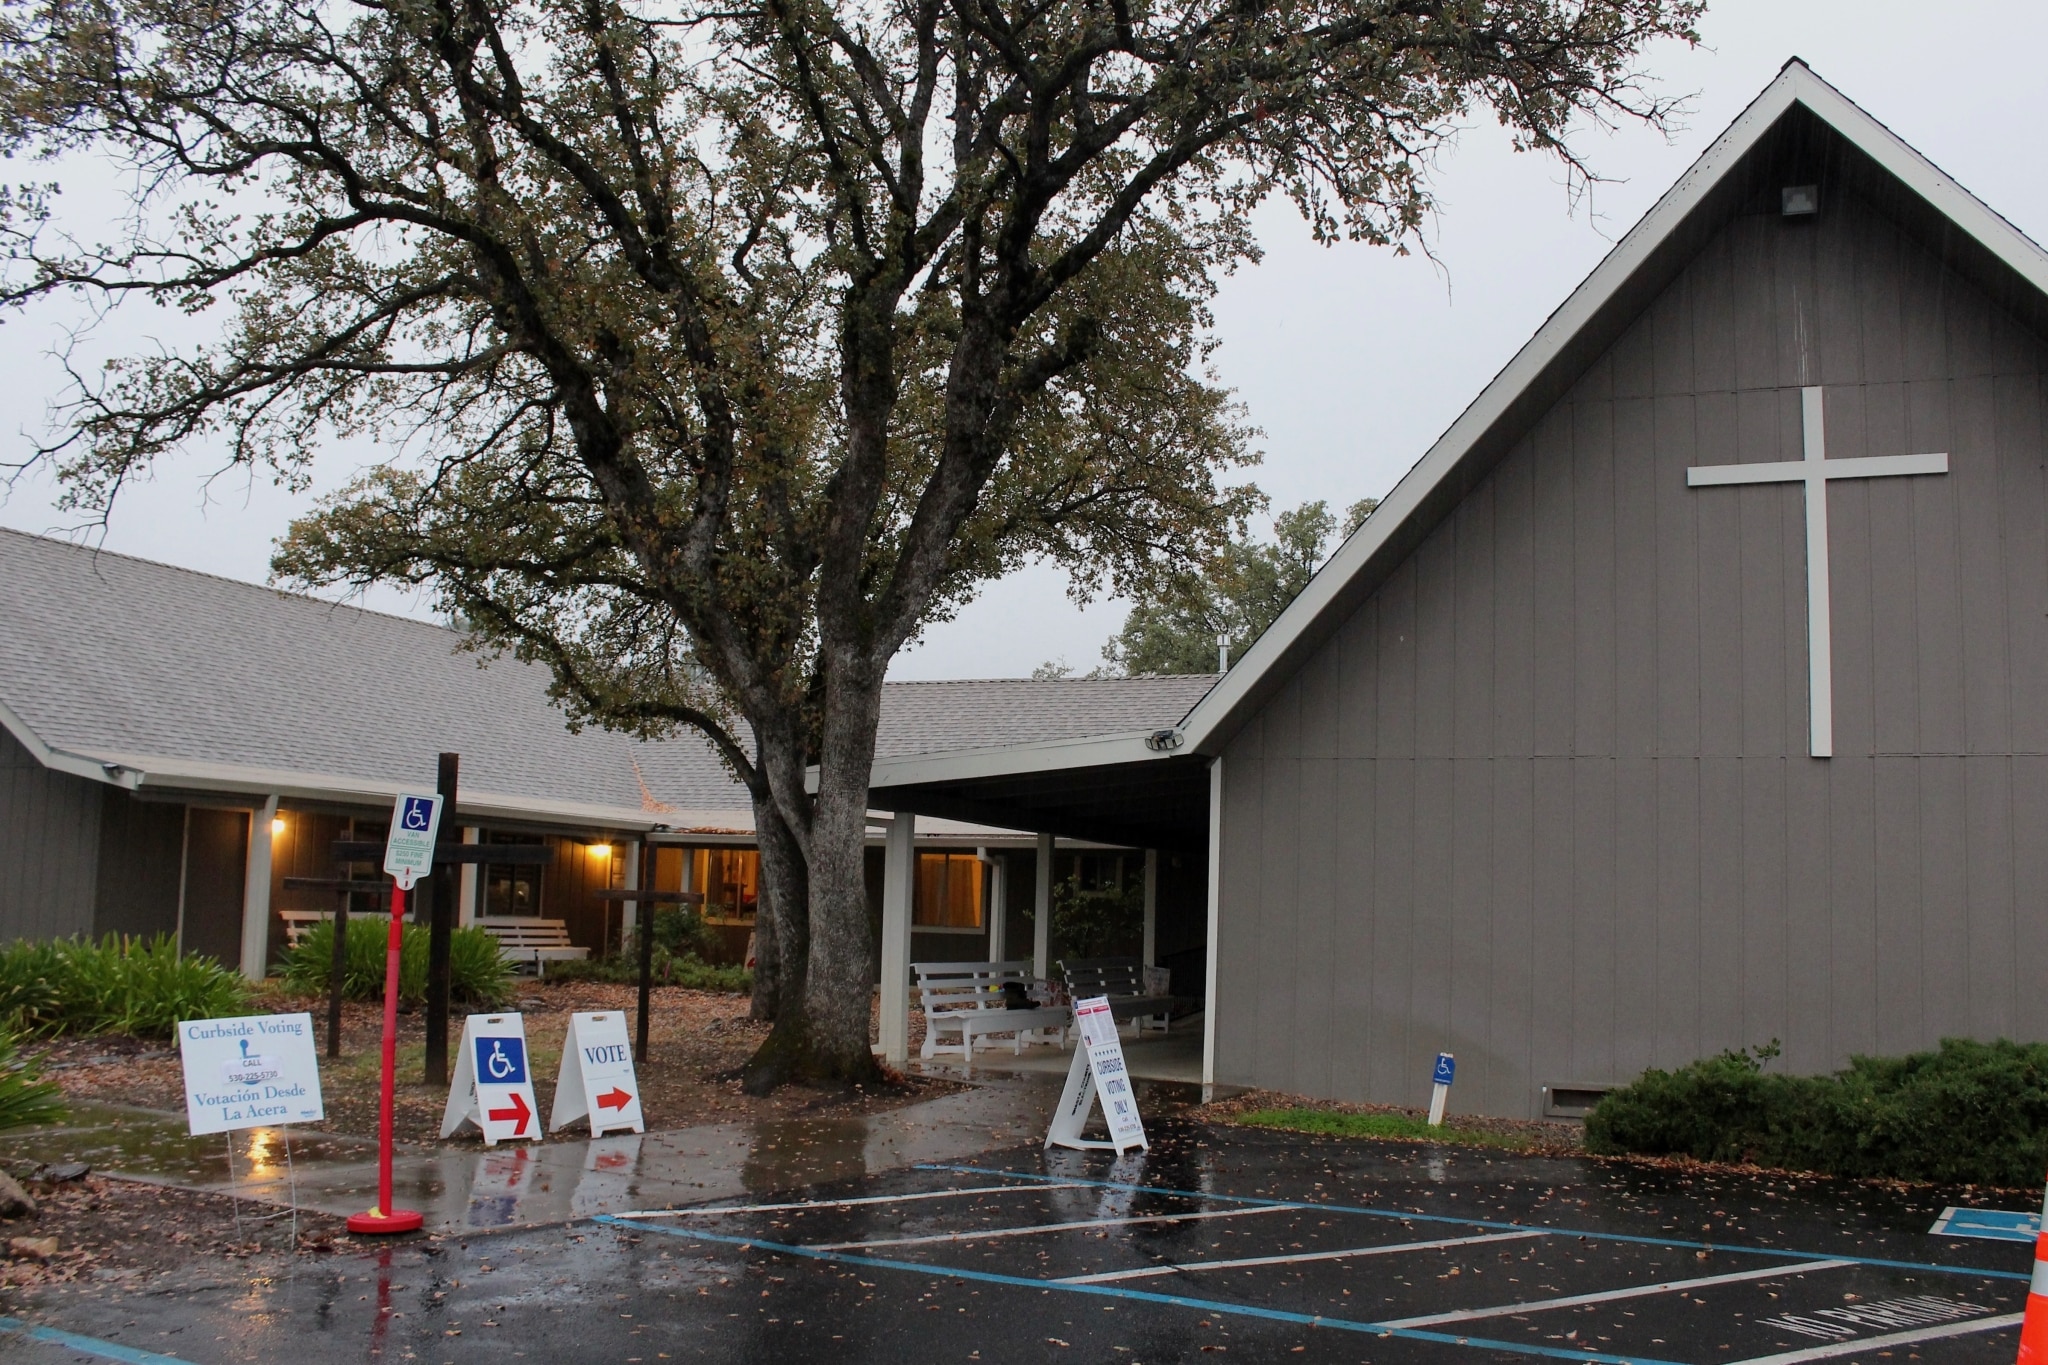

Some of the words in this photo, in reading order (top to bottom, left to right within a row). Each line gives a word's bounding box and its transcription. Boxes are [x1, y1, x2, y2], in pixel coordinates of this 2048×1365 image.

[392, 838, 431, 847] ACCESSIBLE
[395, 858, 422, 866] MINIMUM
[188, 1022, 254, 1040] Curbside
[257, 1020, 303, 1036] Voting
[242, 1059, 262, 1067] CALL
[585, 1044, 627, 1065] VOTE
[1097, 1057, 1123, 1075] CURBSIDE
[228, 1070, 278, 1082] 530-225-5730
[194, 1089, 260, 1107] Votación
[264, 1083, 306, 1099] Desde
[1105, 1078, 1126, 1095] VOTING
[222, 1107, 242, 1121] La
[246, 1104, 288, 1119] Acera
[1114, 1098, 1129, 1115] ONLY
[1755, 1315, 1858, 1340] NO
[1813, 1295, 1990, 1330] PARKING
